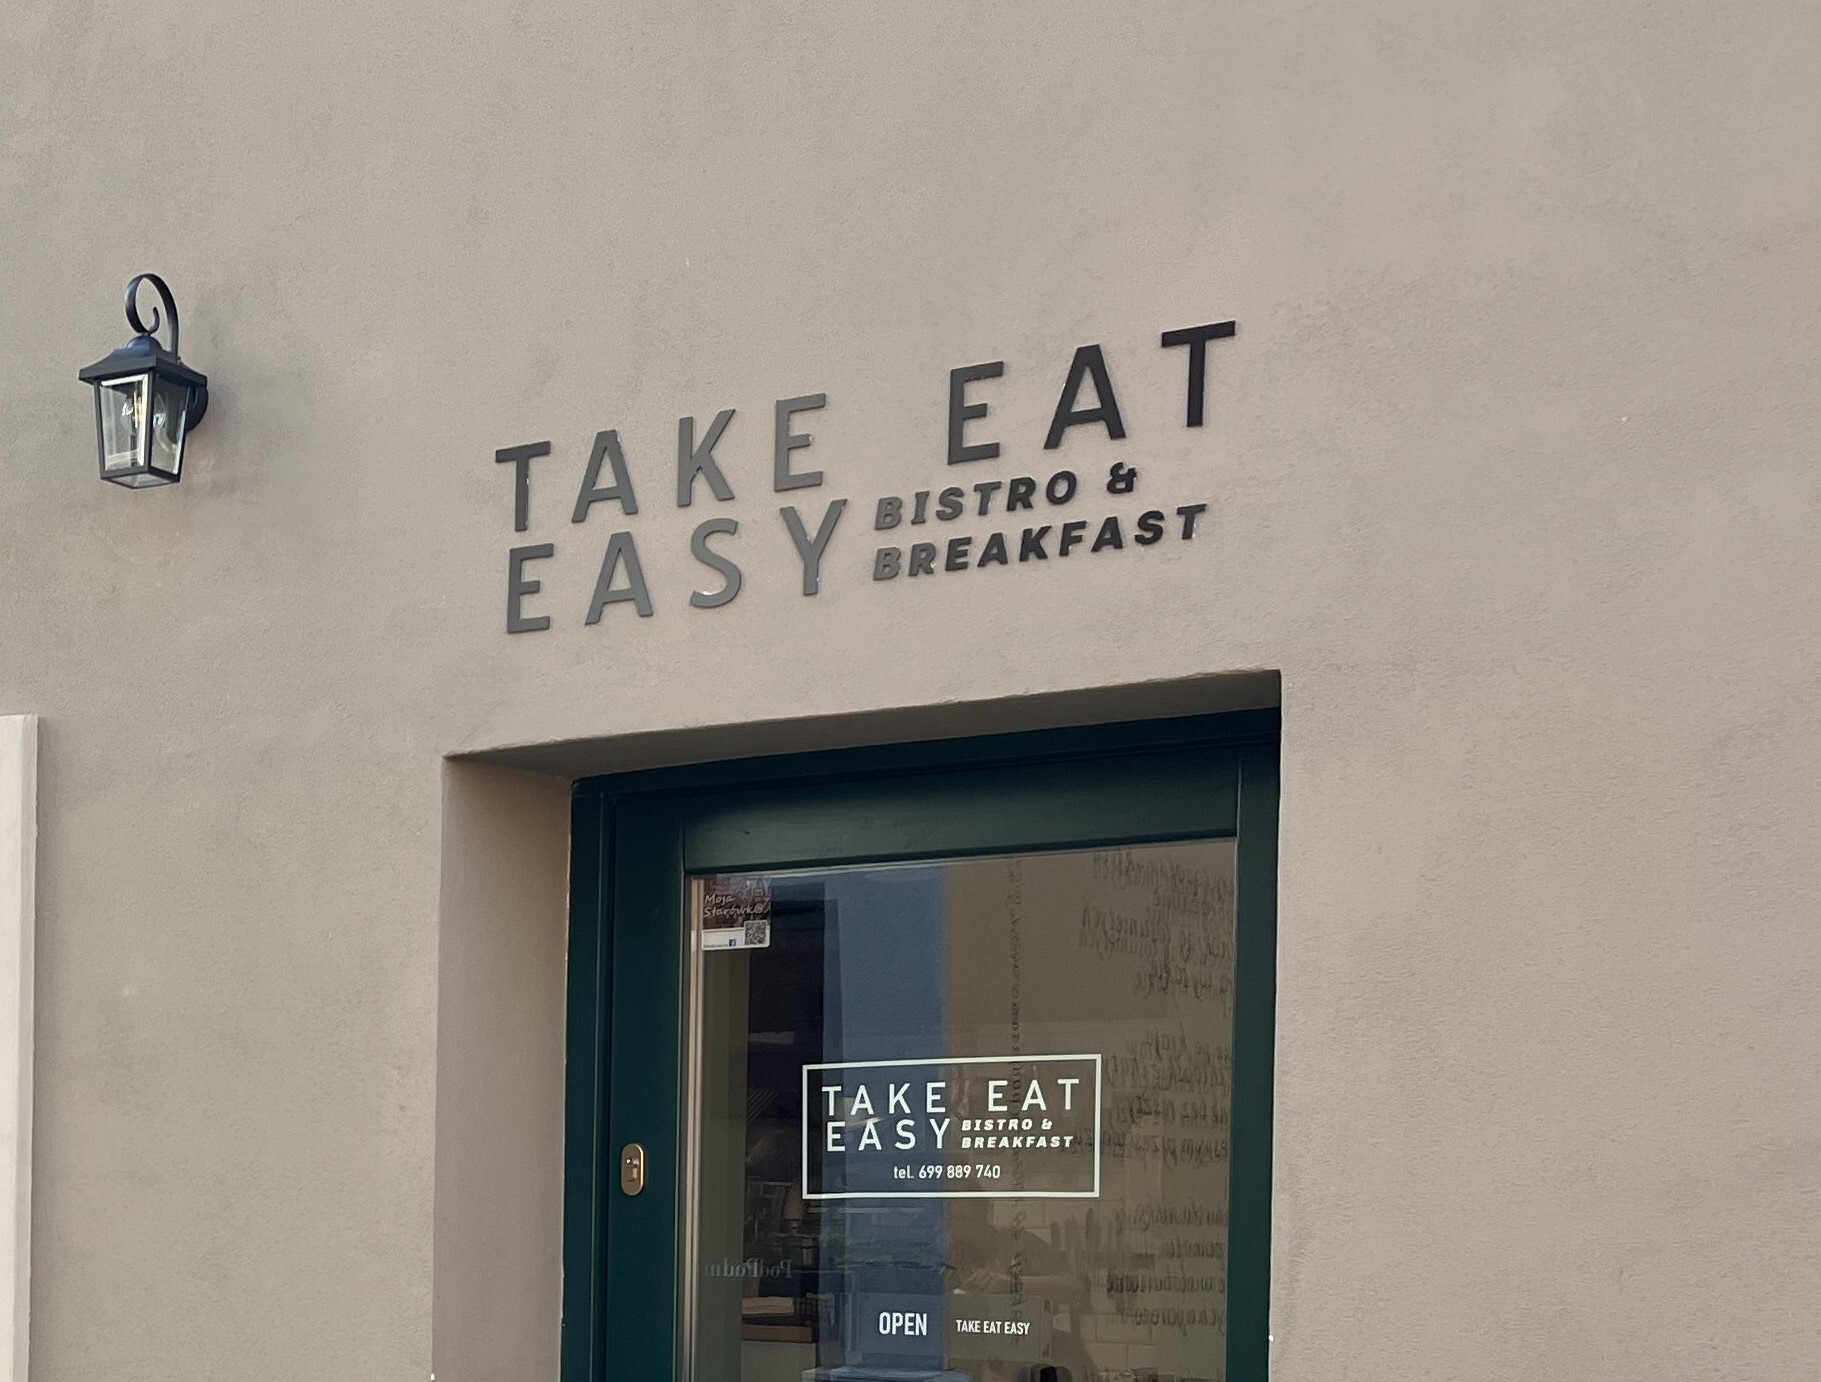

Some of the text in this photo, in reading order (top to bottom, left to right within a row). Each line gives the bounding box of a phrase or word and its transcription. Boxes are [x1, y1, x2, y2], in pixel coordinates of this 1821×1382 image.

[495, 320, 1237, 532] TAKE EAT
[874, 461, 1138, 531] BISTRO &
[872, 503, 1208, 581] BREAKFAST
[507, 498, 847, 634] EASY
[822, 1081, 947, 1116] TAKE
[988, 1078, 1080, 1112] EAT
[826, 1118, 951, 1152] EASY
[961, 1118, 1053, 1132] BISTRO &
[961, 1136, 1075, 1149] BREAKFAST
[893, 1164, 1001, 1179] tel. 699 889 740
[879, 1311, 1030, 1336] OPEN TAKE EAT EASY
